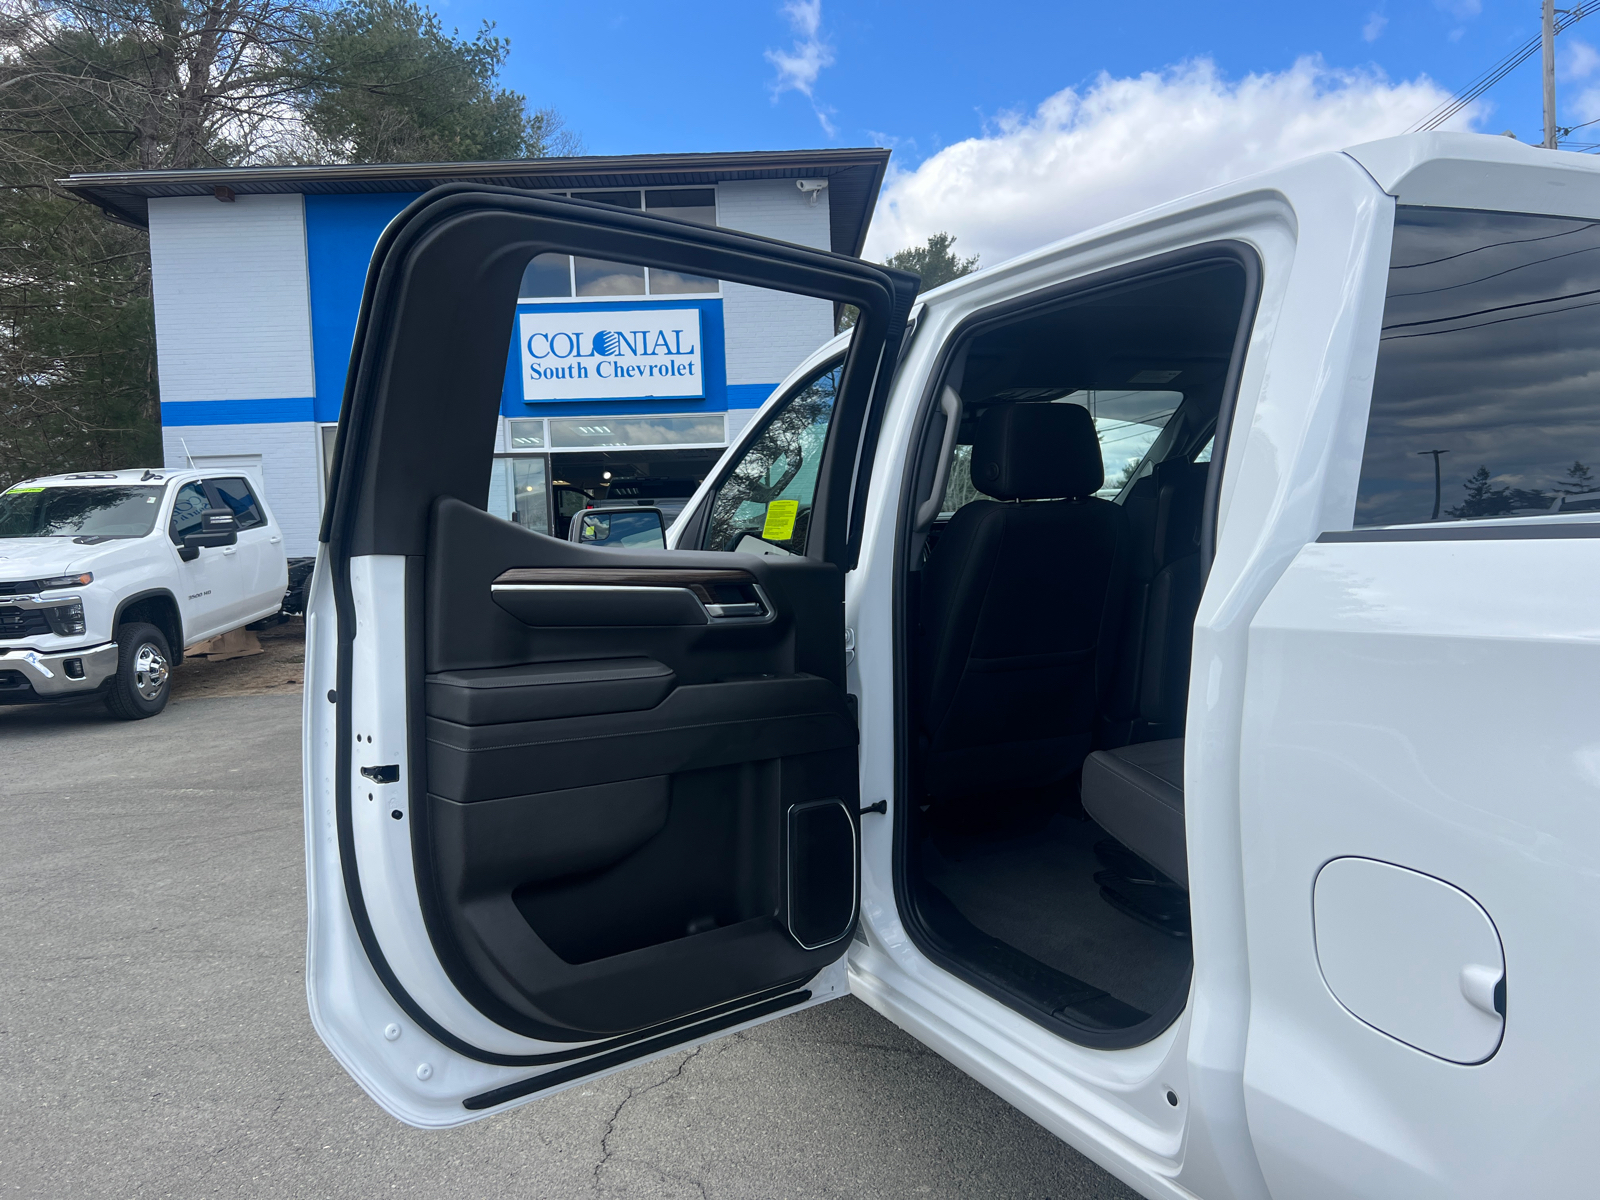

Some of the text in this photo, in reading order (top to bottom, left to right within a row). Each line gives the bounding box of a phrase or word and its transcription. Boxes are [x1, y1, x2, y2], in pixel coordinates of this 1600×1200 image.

[527, 330, 695, 358] COLONIAL
[530, 360, 695, 380] South Chevrolet
[188, 592, 203, 600] 3500
